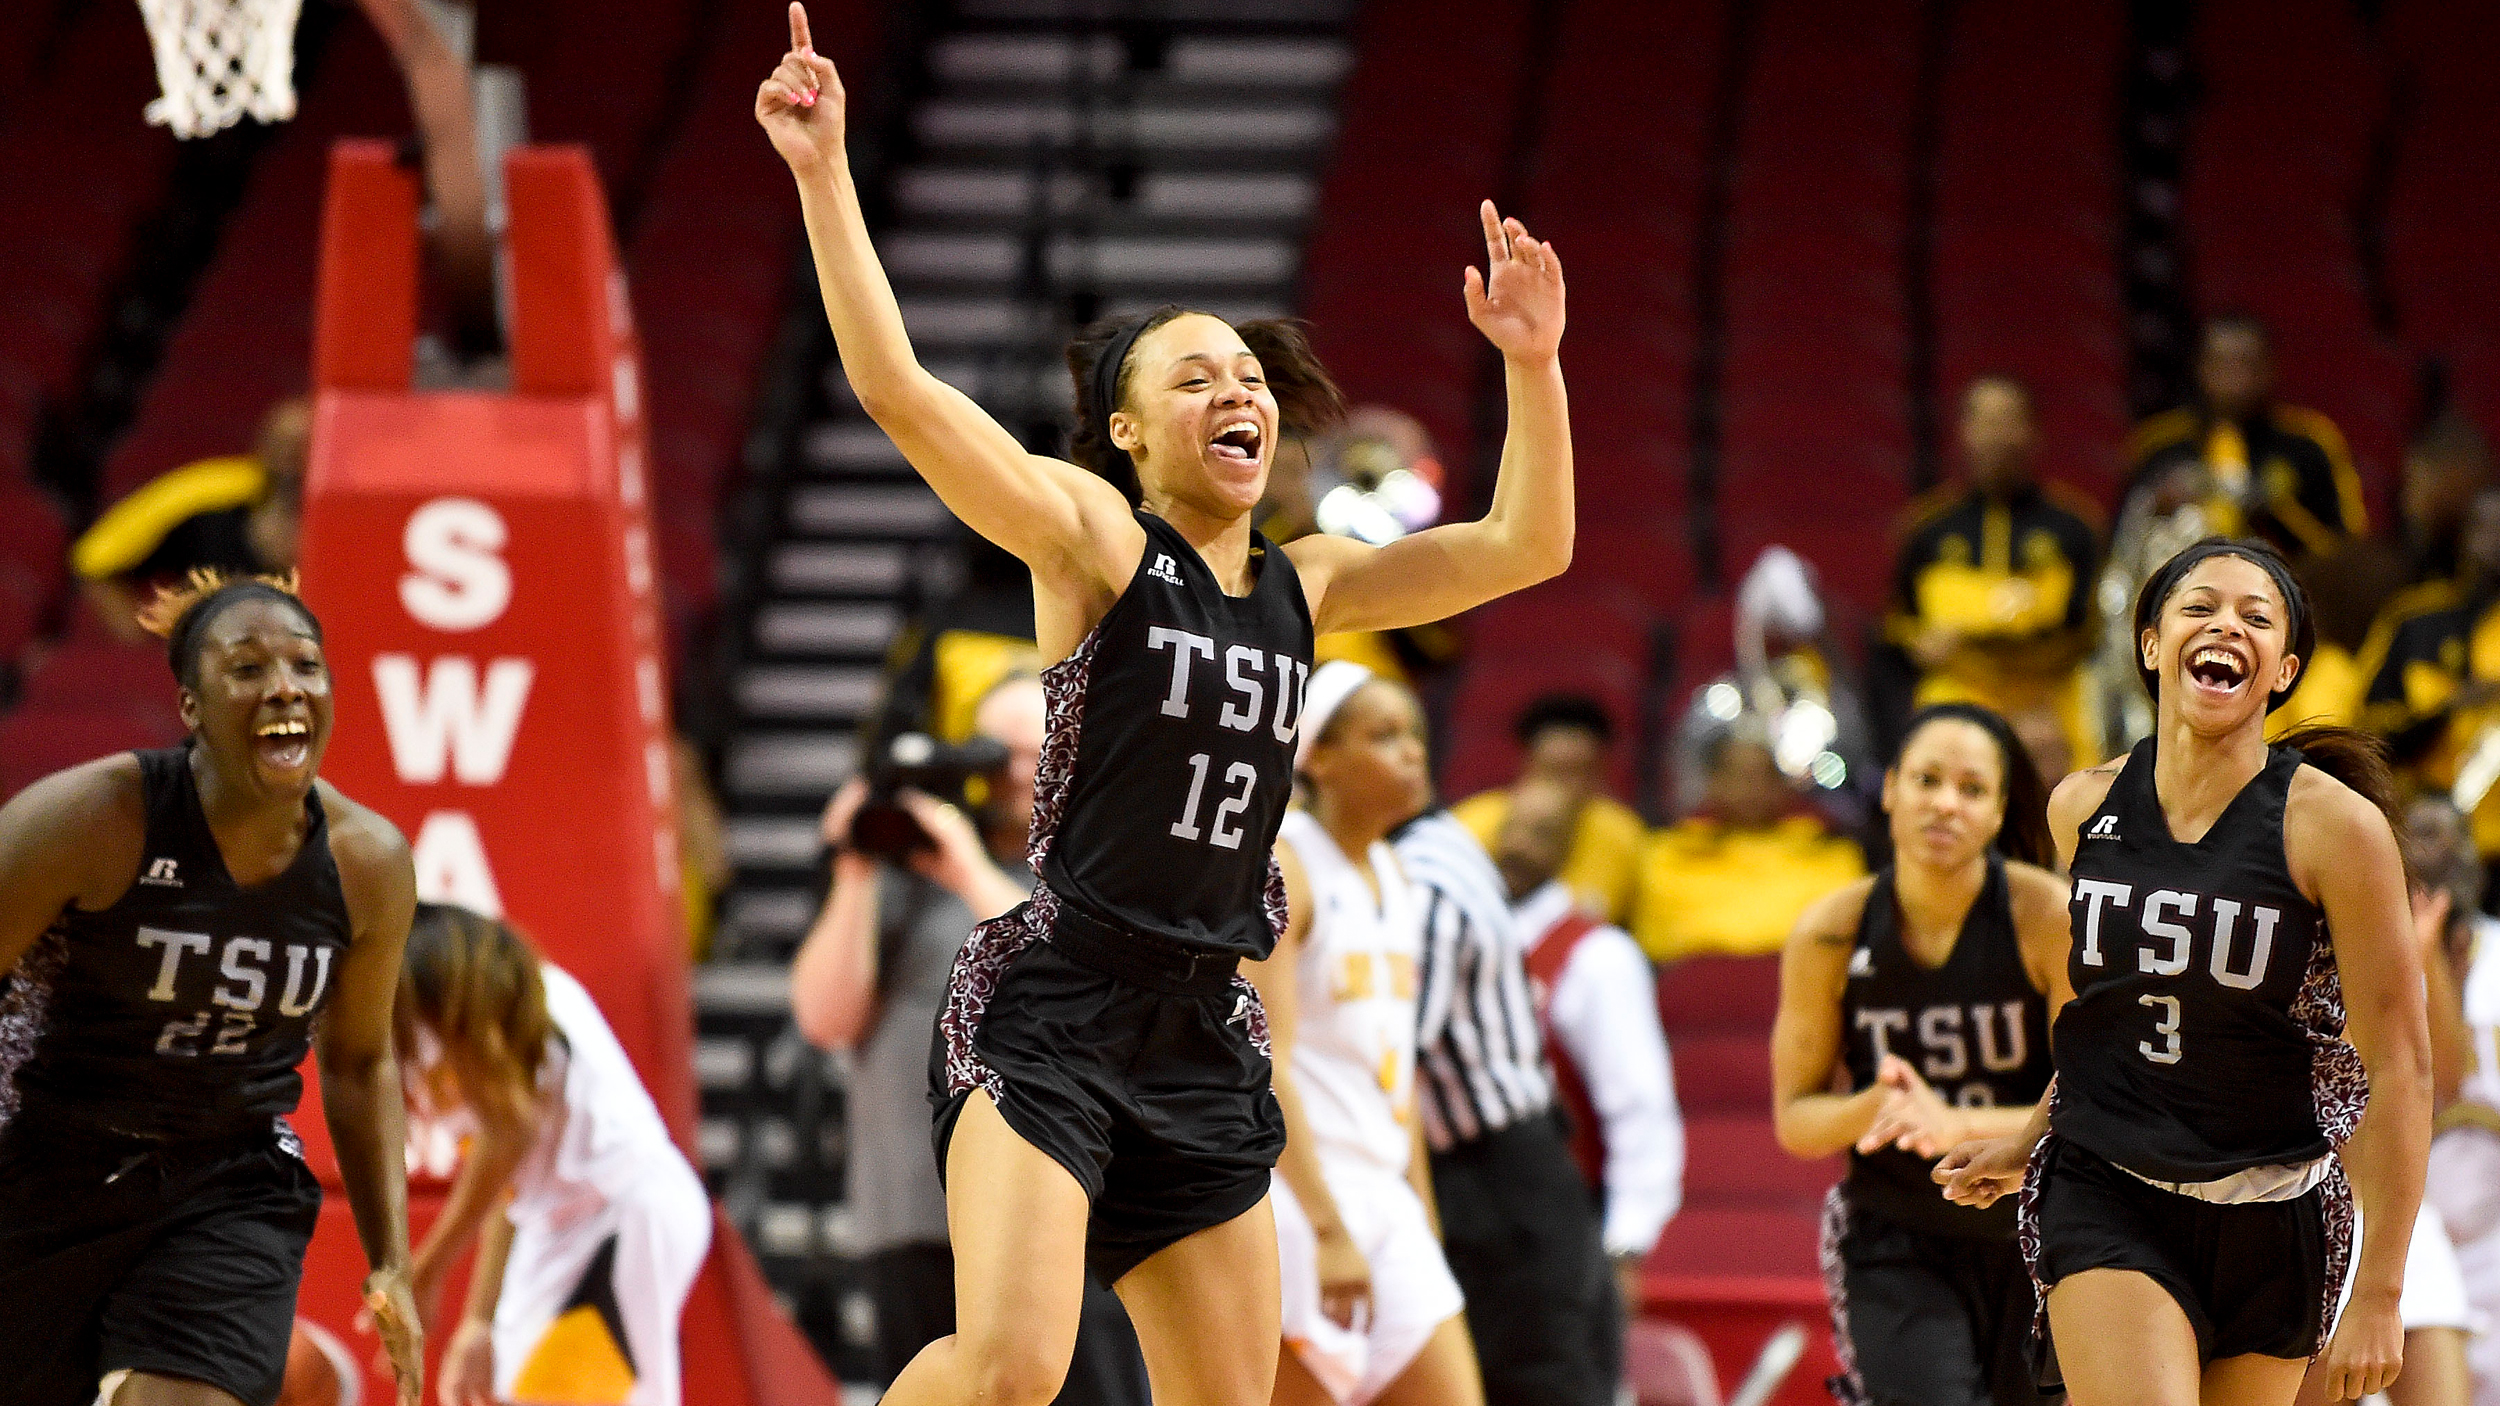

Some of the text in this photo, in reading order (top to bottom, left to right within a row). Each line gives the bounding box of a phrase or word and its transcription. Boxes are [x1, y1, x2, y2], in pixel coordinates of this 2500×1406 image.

[1148, 626, 1308, 744] TSU
[1170, 753, 1257, 850] 12
[136, 926, 333, 1018] TSU
[2075, 878, 2280, 991] TSU
[155, 1011, 256, 1057] 22
[1854, 1000, 2028, 1080] TSU
[2138, 994, 2182, 1065] 3
